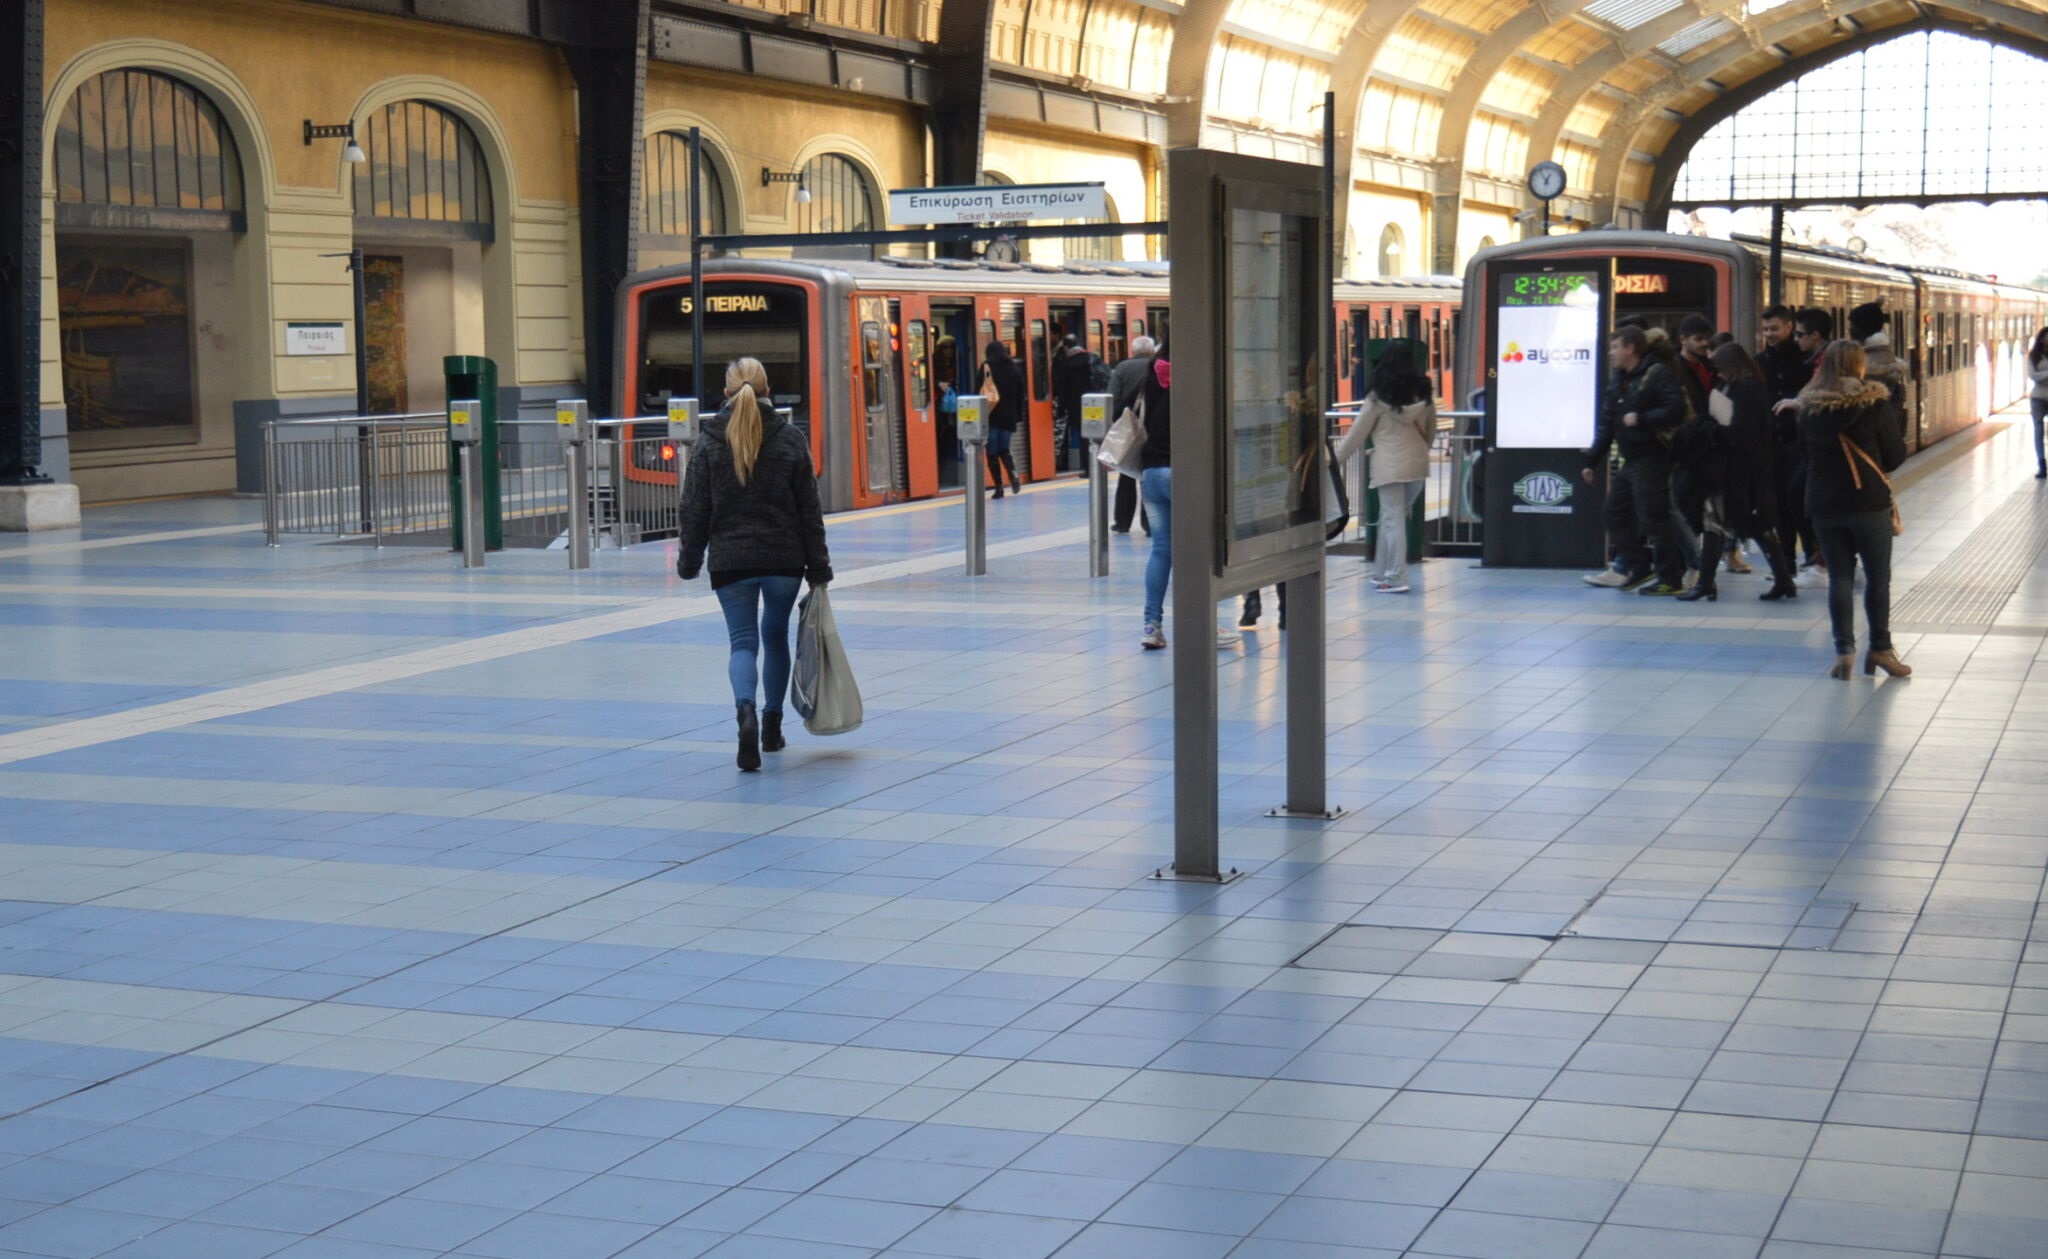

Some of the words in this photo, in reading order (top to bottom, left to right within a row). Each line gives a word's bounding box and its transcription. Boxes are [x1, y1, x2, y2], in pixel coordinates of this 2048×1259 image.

[909, 195, 993, 210] Επικύρωση
[1001, 191, 1085, 207] Εισιτηρίων
[957, 212, 985, 221] Ticket
[989, 209, 1033, 220] Validation
[680, 296, 693, 314] 5
[706, 295, 768, 313] ΠΕΙΡΑΙΑ
[1527, 348, 1590, 364] aycom
[1526, 476, 1561, 502] ΣΤΑΣΥ
